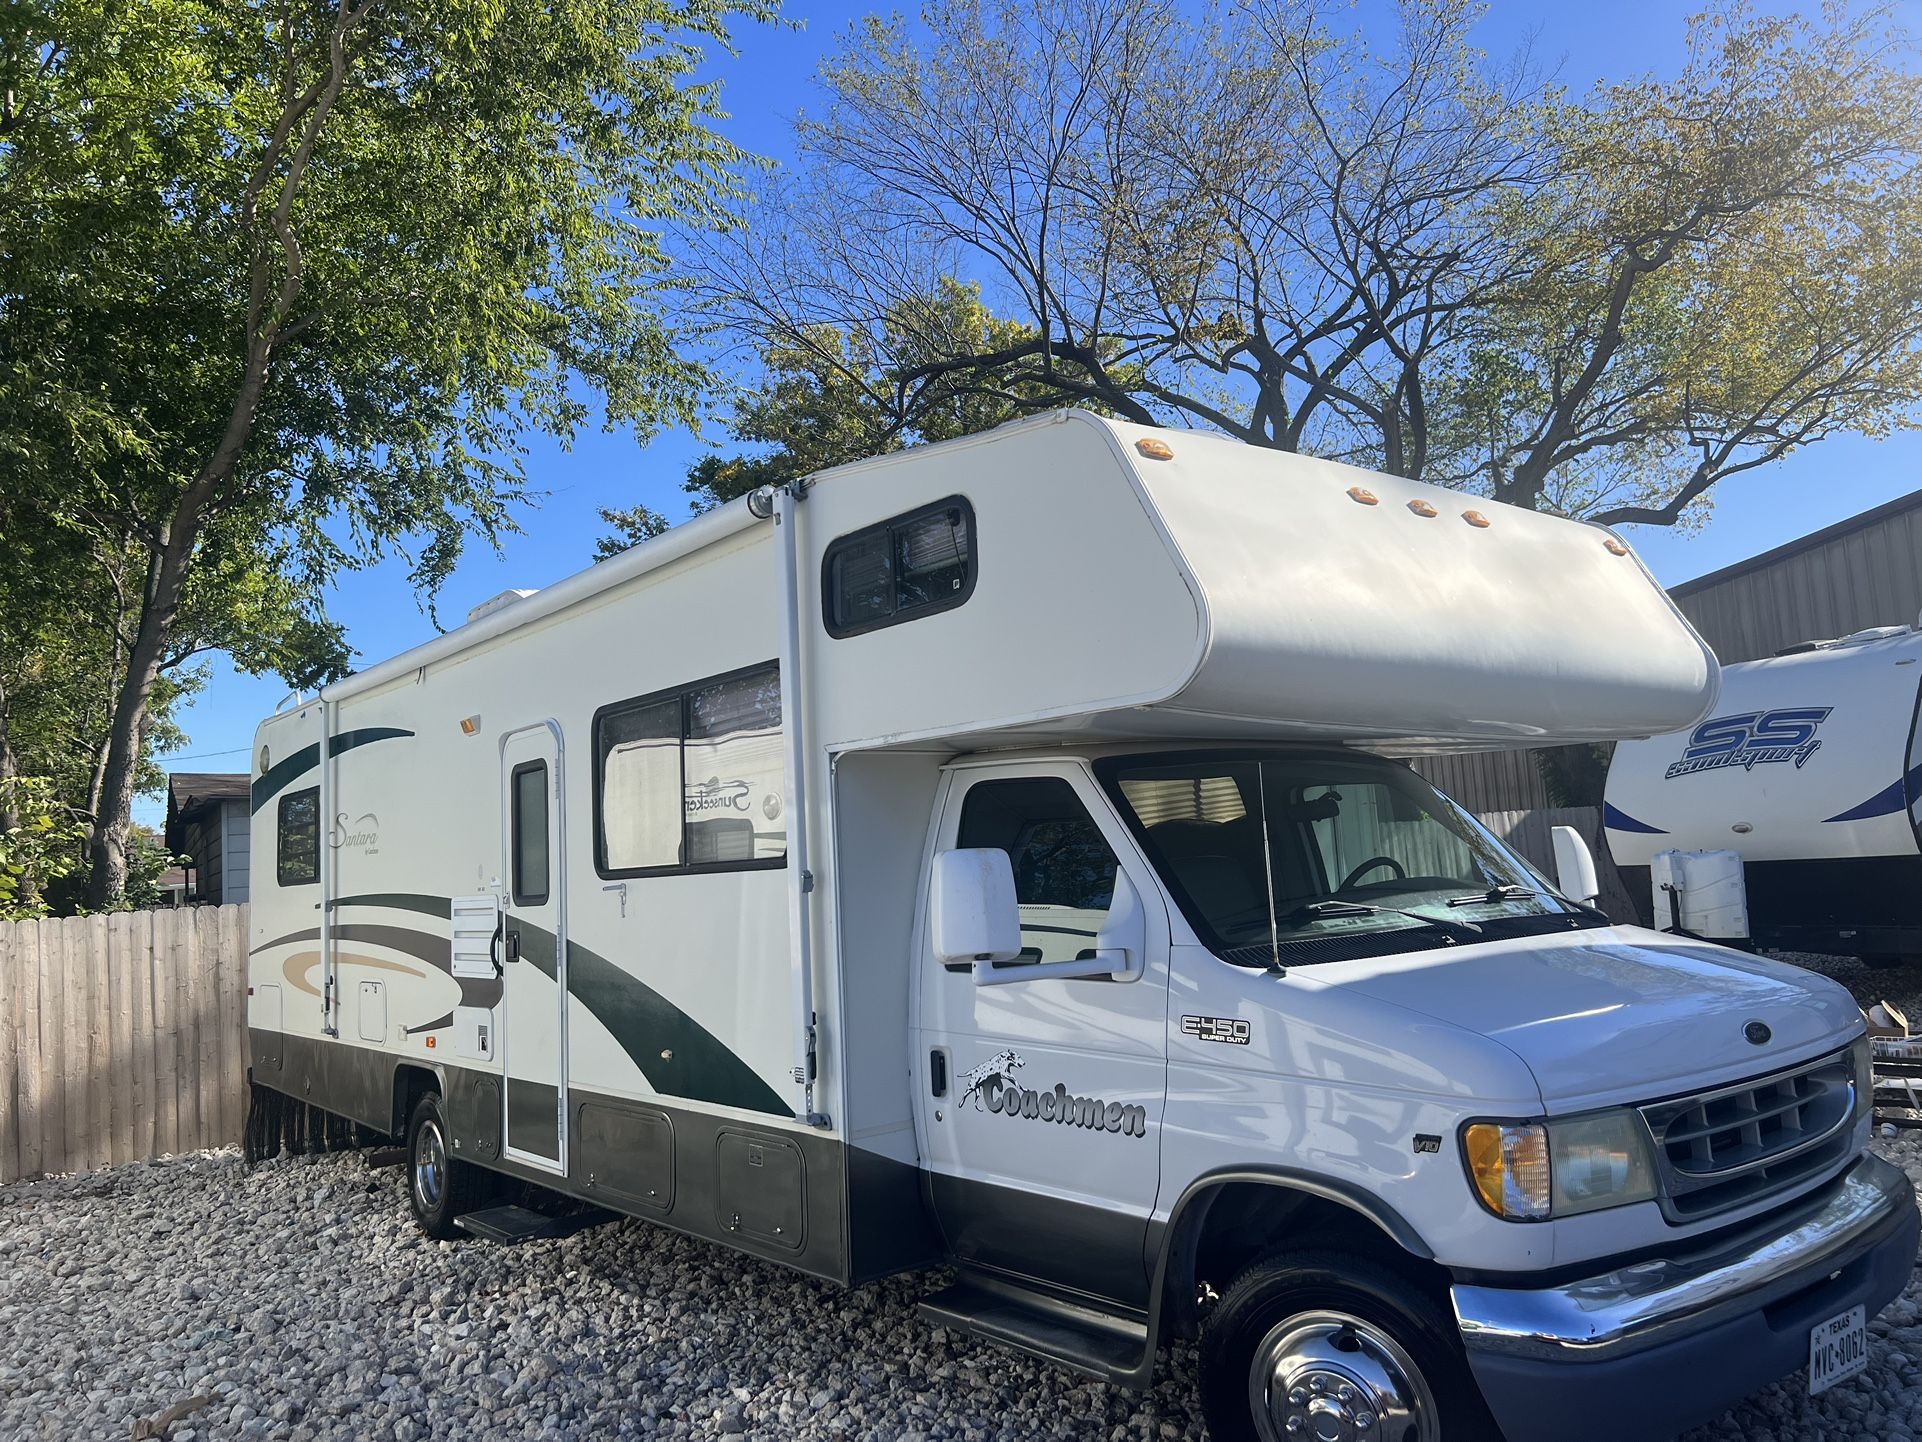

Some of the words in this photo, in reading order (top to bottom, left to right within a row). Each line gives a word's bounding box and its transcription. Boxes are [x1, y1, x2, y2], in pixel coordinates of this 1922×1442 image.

[1681, 706, 1835, 764] SS
[1201, 1033, 1225, 1042] SUPER
[1226, 1036, 1247, 1044] DUTY
[982, 1073, 1146, 1138] Coachmen
[1413, 1138, 1440, 1153] V10
[1829, 1315, 1850, 1336] TEXAS
